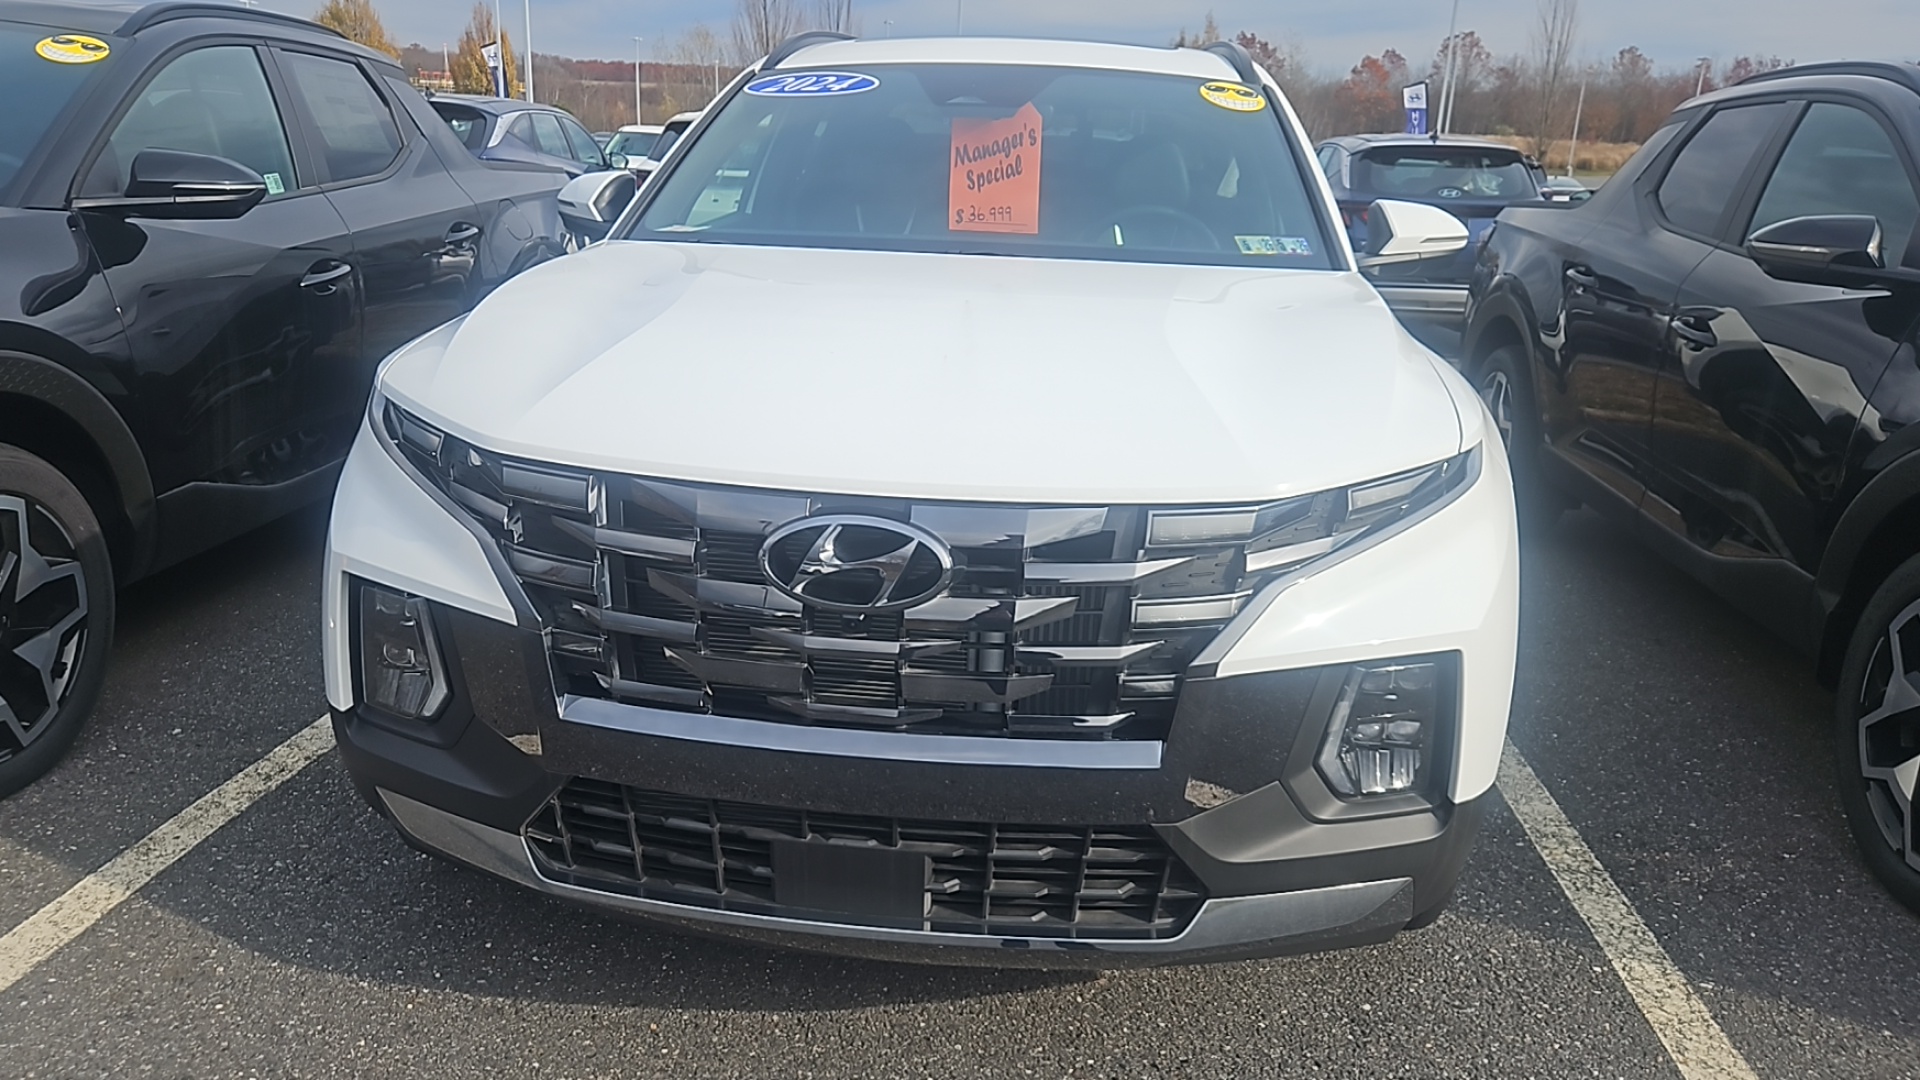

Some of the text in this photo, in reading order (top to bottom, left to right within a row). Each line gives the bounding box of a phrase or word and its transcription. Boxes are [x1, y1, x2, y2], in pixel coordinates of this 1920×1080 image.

[760, 76, 863, 92] 2024
[954, 122, 1038, 168] Manager's
[966, 154, 1023, 193] Special
